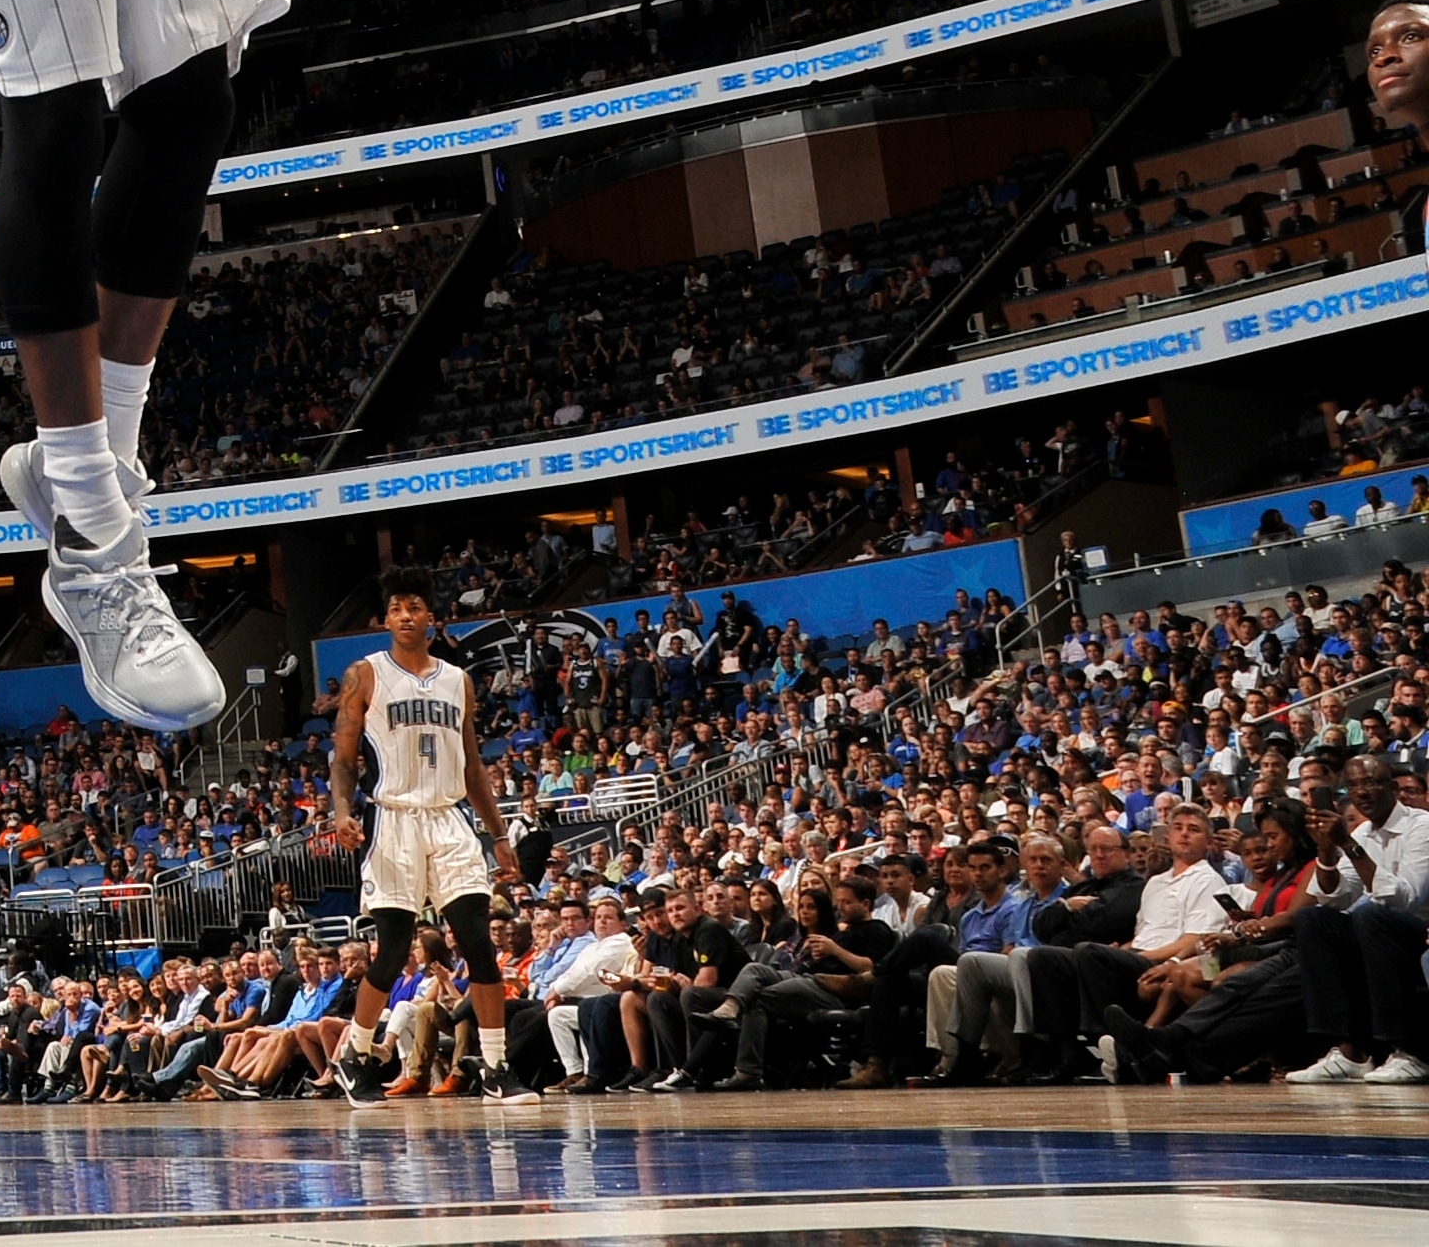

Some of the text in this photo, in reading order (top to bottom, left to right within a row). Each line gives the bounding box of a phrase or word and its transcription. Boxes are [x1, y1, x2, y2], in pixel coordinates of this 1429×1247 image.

[905, 27, 934, 49] BE
[719, 72, 748, 92] BE
[537, 110, 565, 130] BE
[361, 142, 388, 162] BE
[1224, 313, 1263, 344] BE
[984, 328, 1202, 395] BE SPORTSRICH
[757, 379, 962, 438] BE SPORTSRICH
[540, 424, 735, 476] BE SPORTSRICH
[339, 458, 531, 505] BE SPORTSRICH
[165, 489, 319, 526] SPORTSRICH
[385, 698, 463, 734] MAGIC
[418, 732, 438, 769] 4
